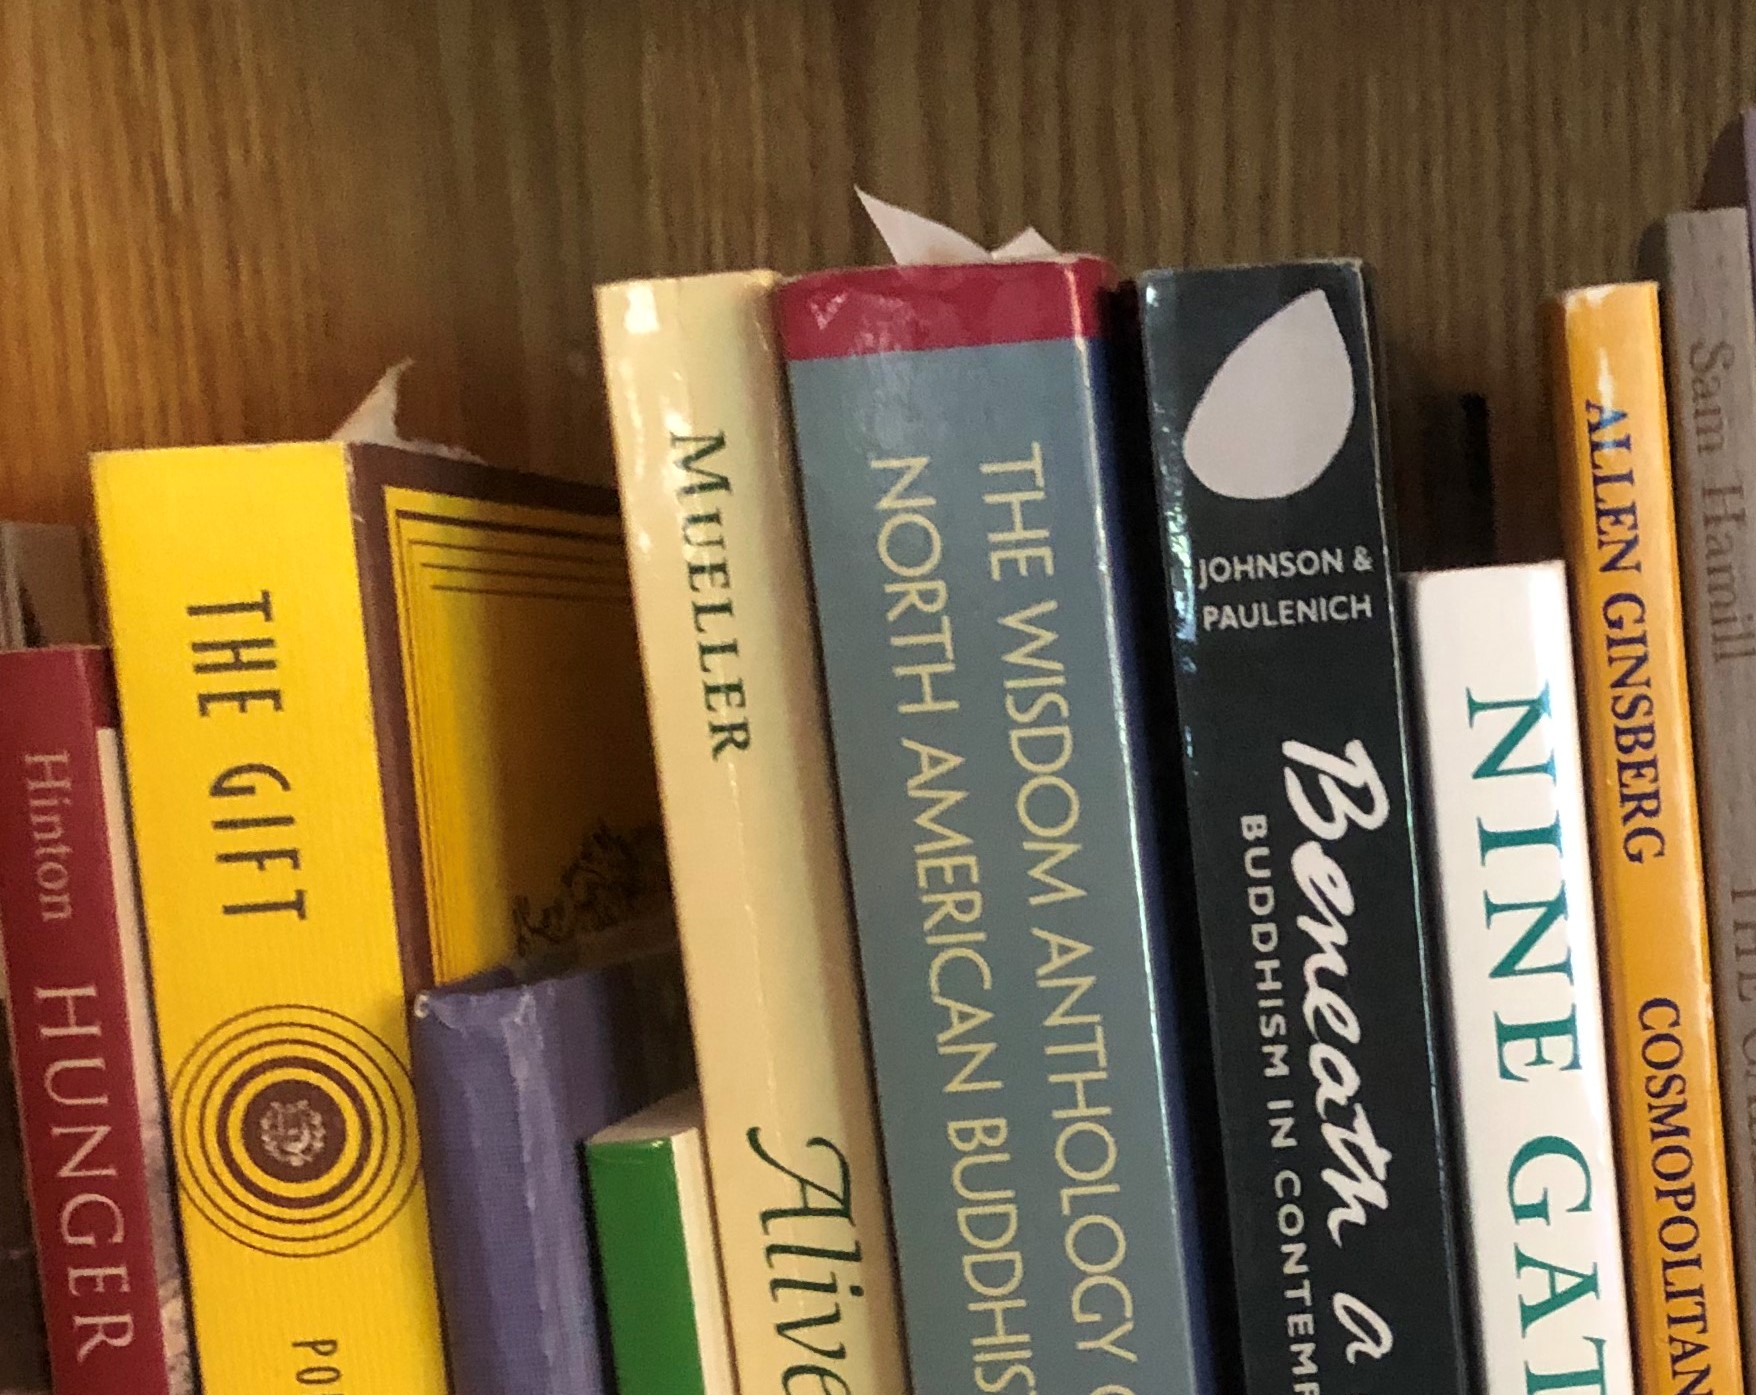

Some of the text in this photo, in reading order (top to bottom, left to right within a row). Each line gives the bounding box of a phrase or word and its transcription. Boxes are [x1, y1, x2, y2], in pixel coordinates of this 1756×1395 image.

[670, 429, 752, 762] MUELLER
[869, 456, 959, 713] NORTH
[980, 441, 1054, 581] THE
[1199, 545, 1374, 590] JOHNSON &
[1202, 594, 1373, 631] PAULENICH
[1584, 398, 1666, 866] ALLEN GINSBERG
[1689, 339, 1756, 665] Sam Hamill
[25, 750, 72, 921] Hinton
[186, 590, 307, 920] THE GIFT
[901, 738, 1004, 1093] AMERICAN
[996, 600, 1088, 906] WISDOM
[1465, 679, 1583, 1083] NINE
[1030, 927, 1138, 1363] ANTHOLOGY
[1240, 814, 1290, 1078] BUDDHISM
[1267, 1099, 1298, 1149] IN
[1281, 738, 1393, 1248] Beneath
[35, 984, 136, 1360] HUNGER
[1332, 1292, 1393, 1365] a
